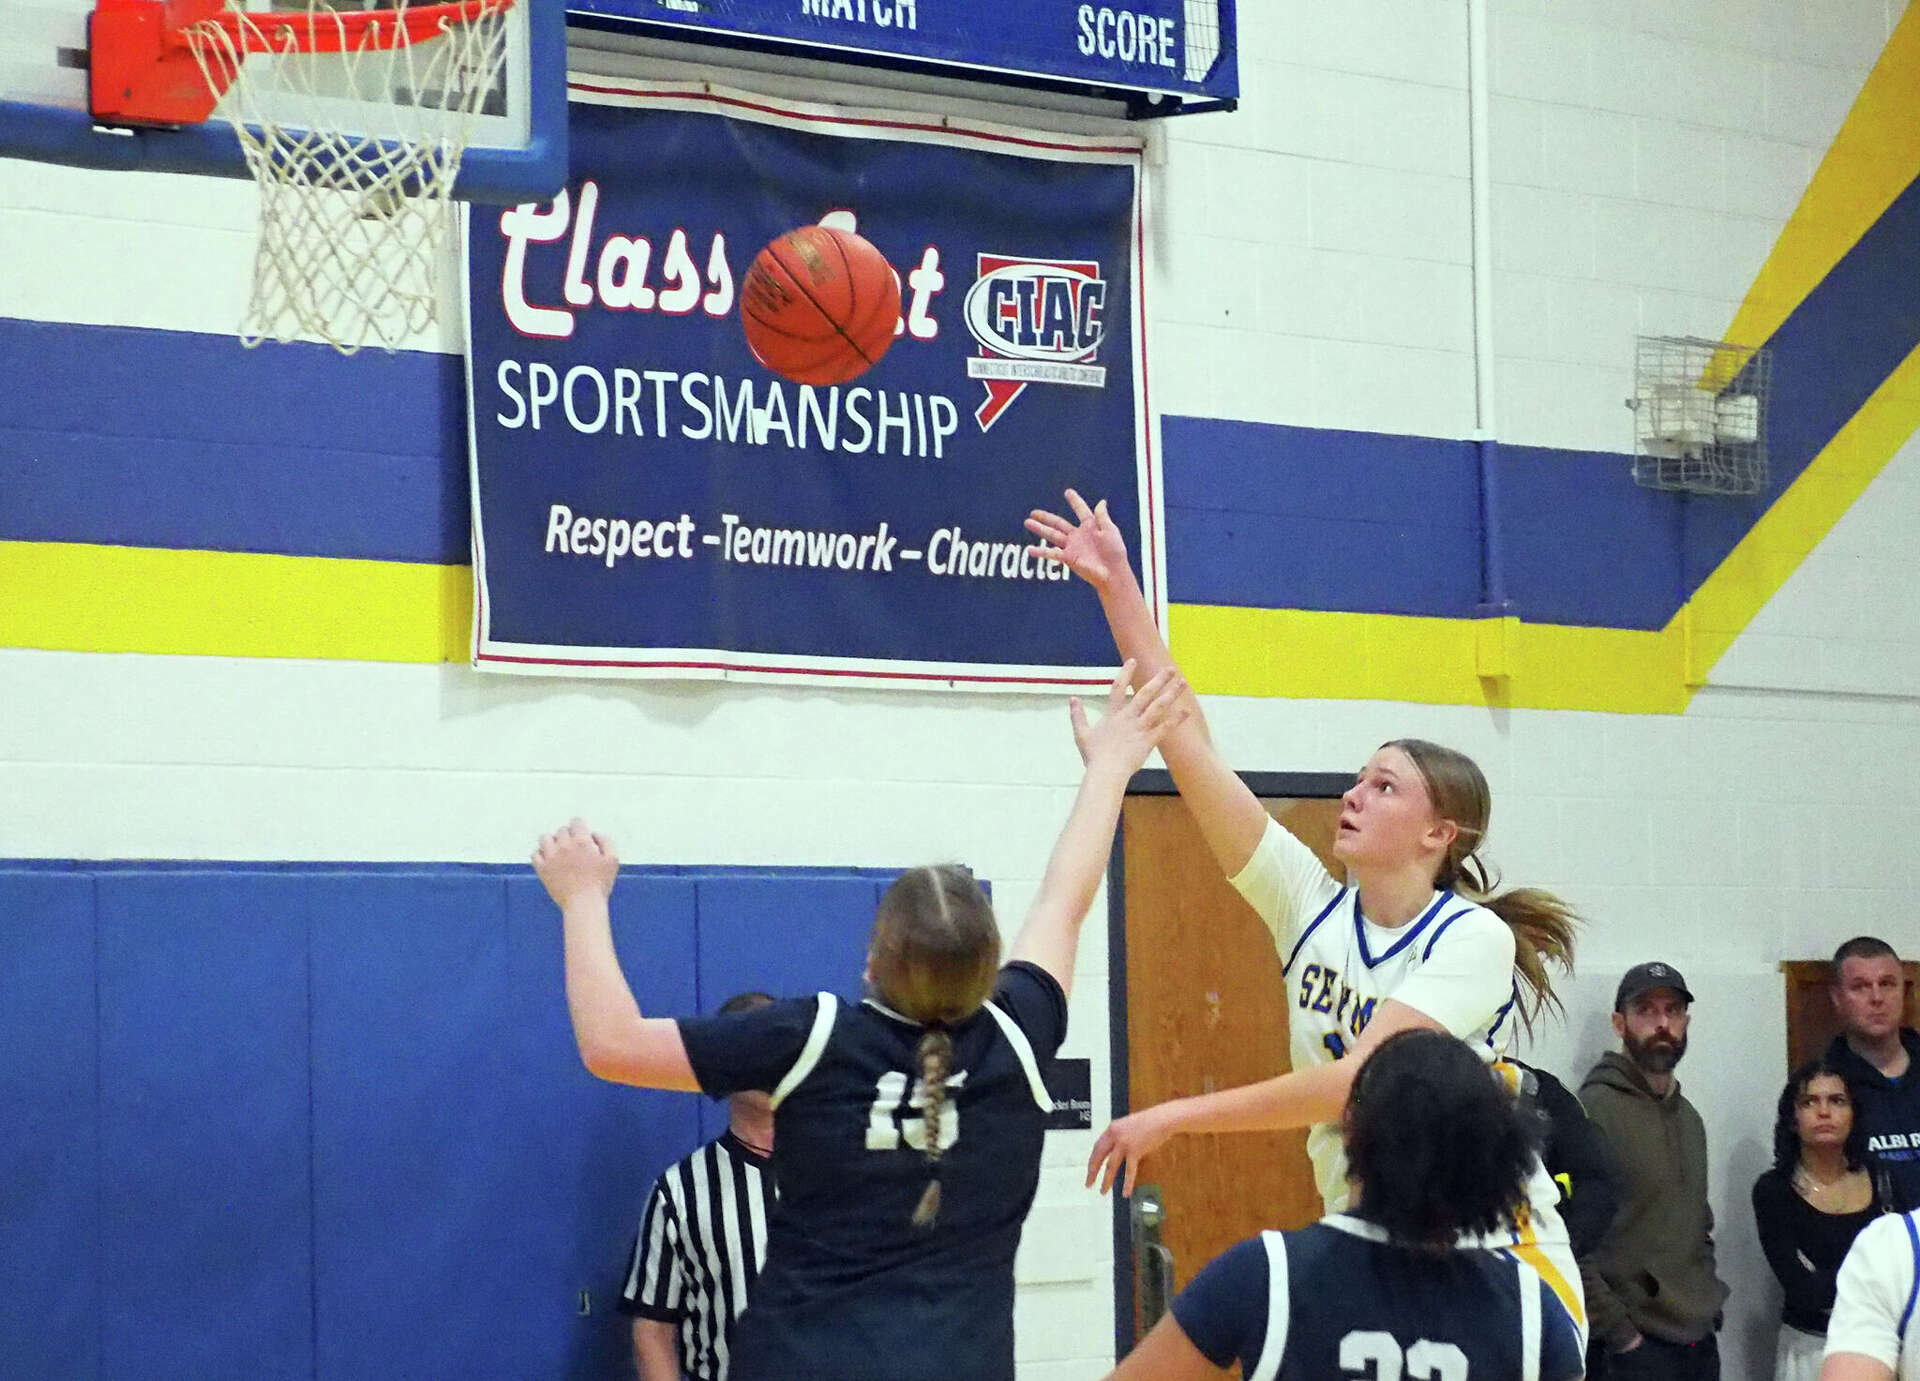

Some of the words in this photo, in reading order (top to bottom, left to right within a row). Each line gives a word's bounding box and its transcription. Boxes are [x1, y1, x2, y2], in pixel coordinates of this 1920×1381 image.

[1077, 4, 1176, 68] SCORE
[500, 180, 735, 338] Class
[986, 277, 1107, 352] CIAC
[496, 359, 959, 458] SPORTSMANSHIP
[545, 504, 696, 568] Respect
[865, 1071, 969, 1150] 15
[1868, 1134, 1909, 1151] ALBI
